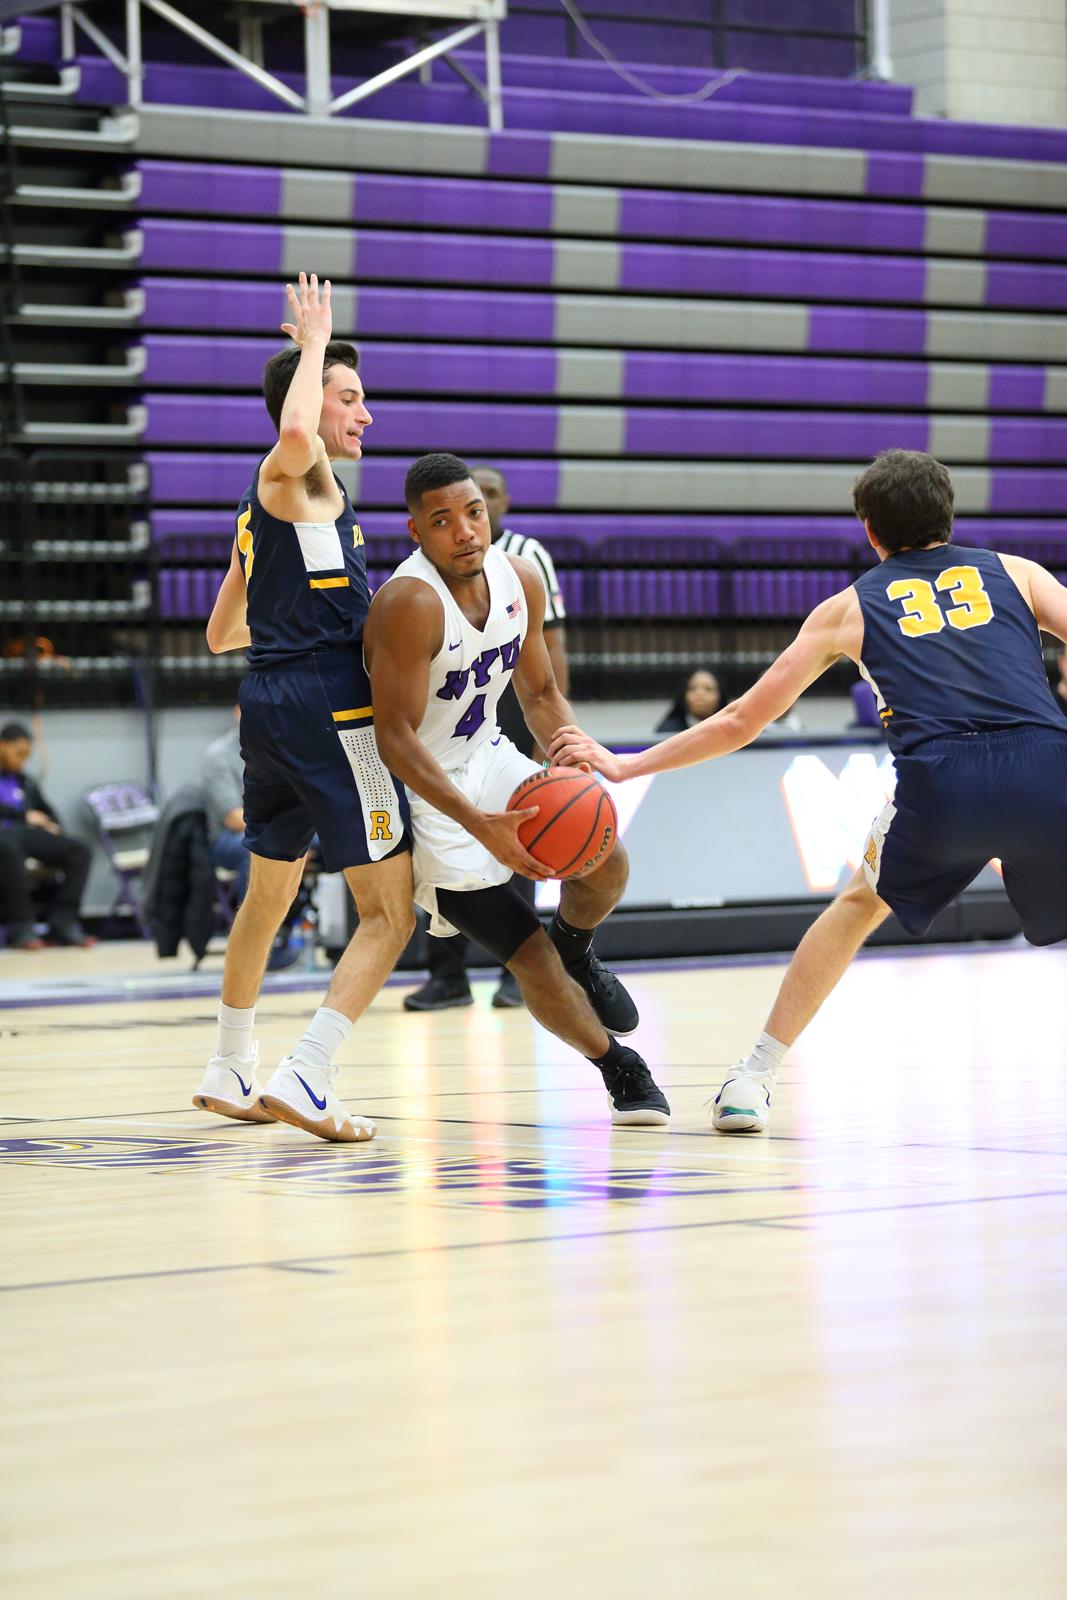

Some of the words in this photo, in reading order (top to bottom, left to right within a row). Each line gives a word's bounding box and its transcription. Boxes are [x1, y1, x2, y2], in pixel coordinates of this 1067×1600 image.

[885, 565, 995, 638] 33
[435, 633, 521, 701] NYU
[450, 693, 487, 742] 4
[369, 810, 393, 840] R
